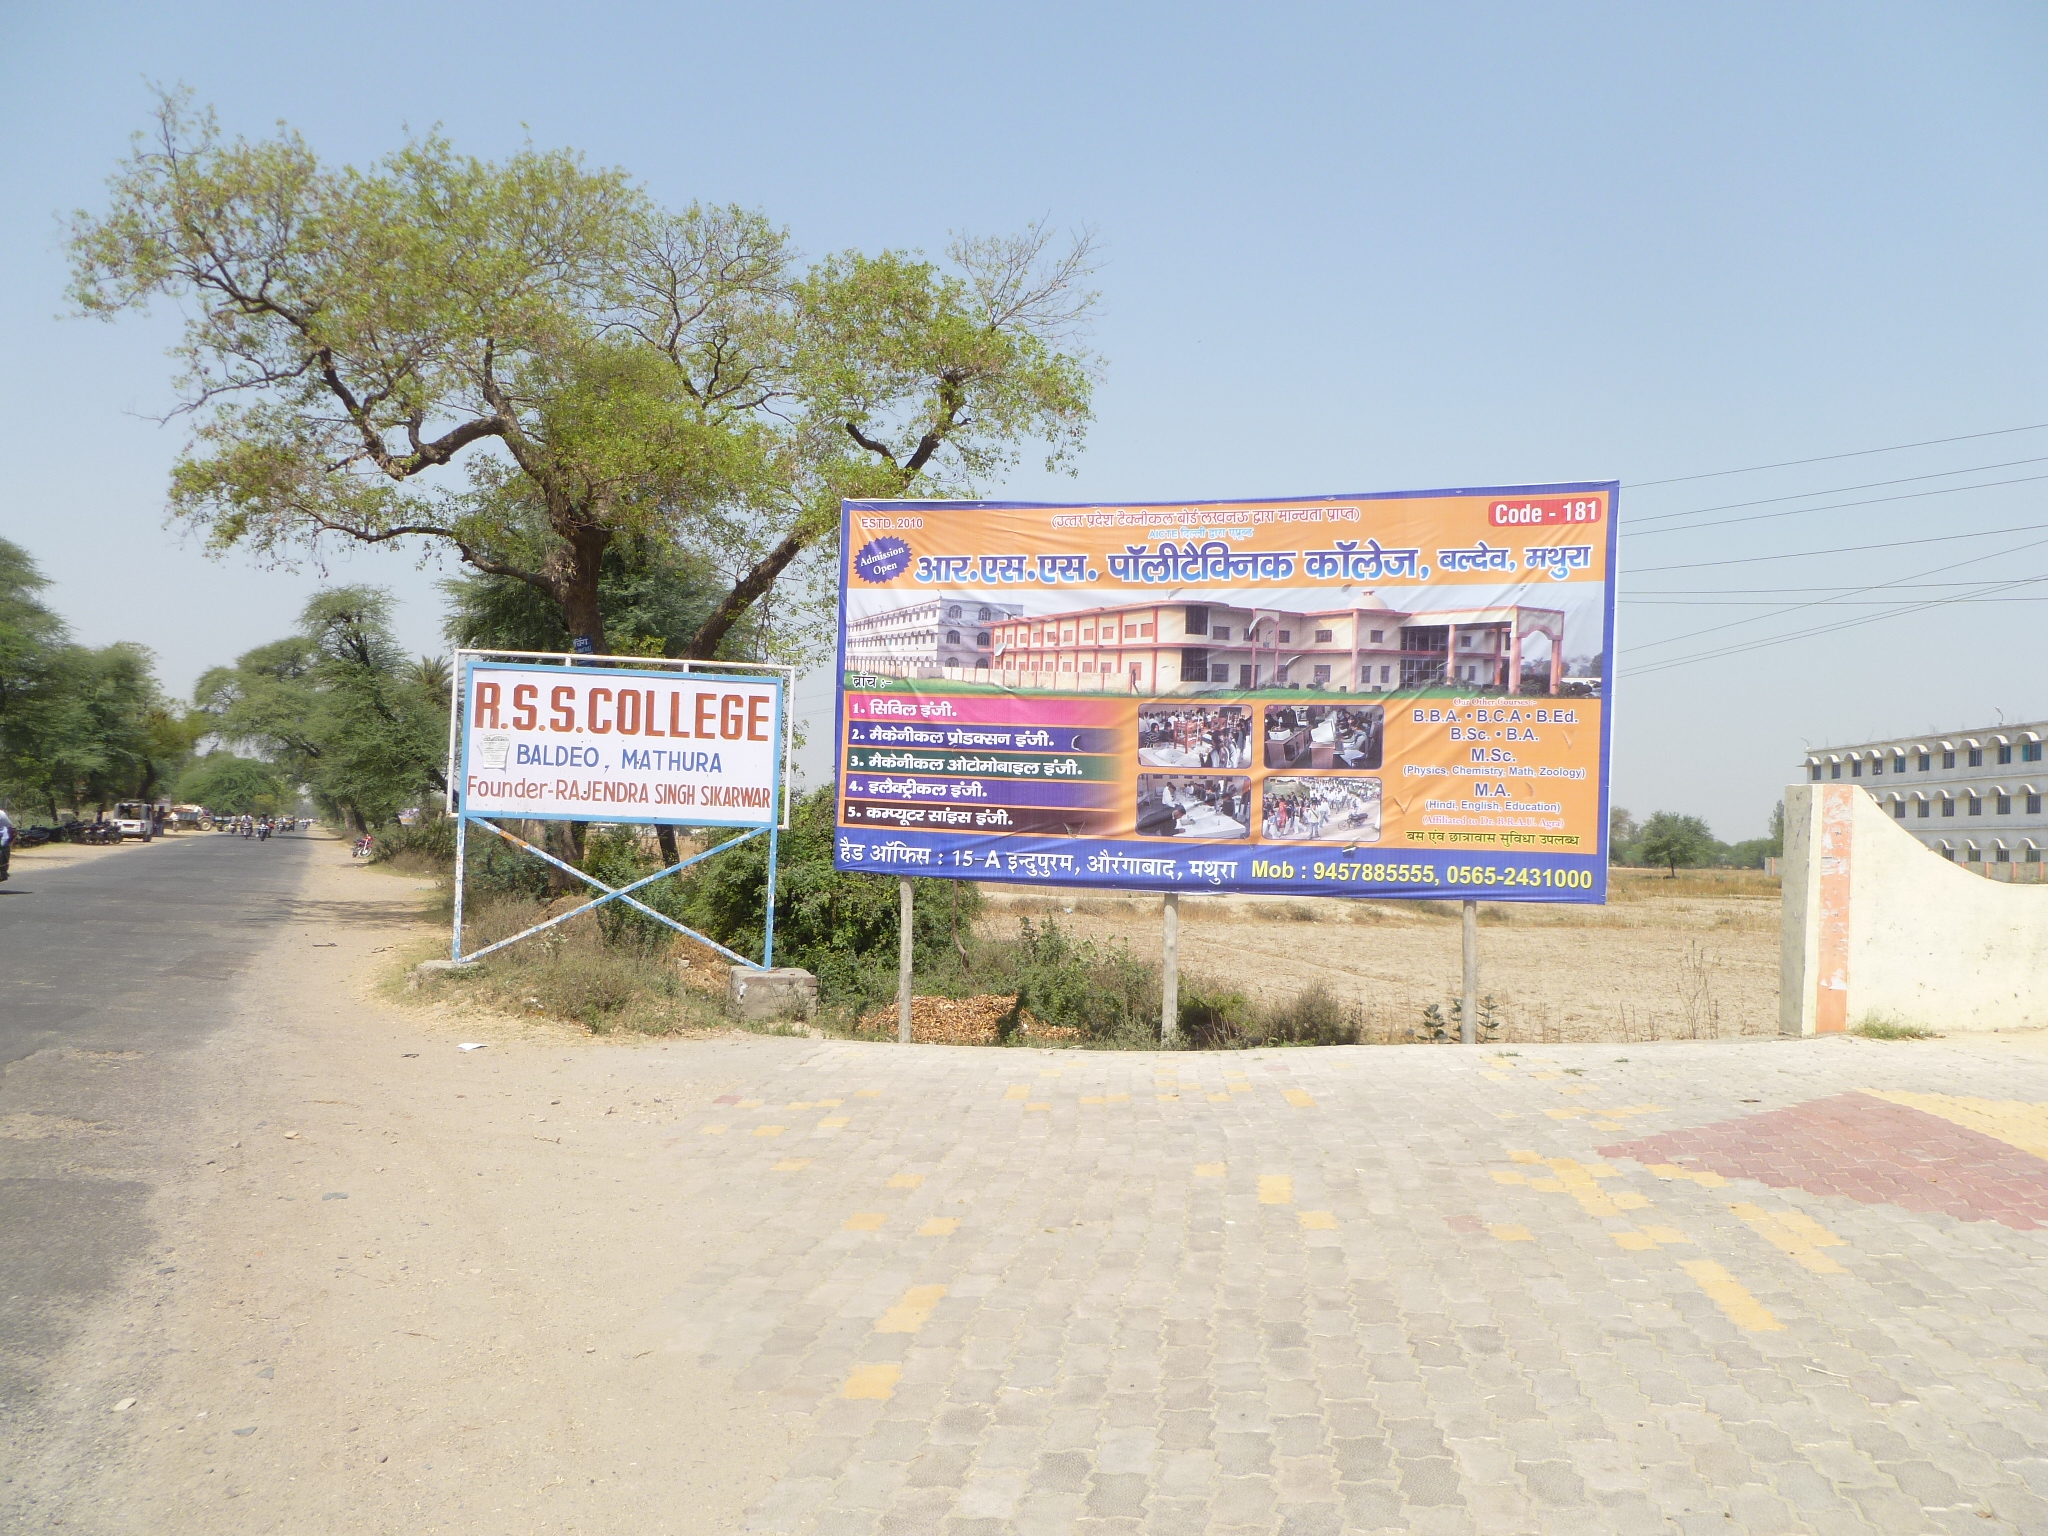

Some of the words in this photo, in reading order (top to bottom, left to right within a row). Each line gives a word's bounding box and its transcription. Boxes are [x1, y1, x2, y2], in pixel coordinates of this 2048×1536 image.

[1087, 511, 1114, 528] प्रदेश
[1178, 509, 1198, 524] बोर्ड
[1200, 510, 1250, 524] लखनऊ
[1252, 510, 1274, 524] द्वारा
[1278, 508, 1322, 522] मान्यता
[1326, 507, 1360, 522] प्राप्त)
[1495, 504, 1542, 524] Code
[1562, 501, 1596, 521] 181
[861, 517, 895, 530] ESTD.
[897, 516, 923, 530] 2010
[1148, 530, 1178, 539] AICTE
[860, 546, 904, 568] Admission
[914, 554, 1099, 584] आर.एस.एस.
[1304, 539, 1431, 580] कॉलेज,
[1438, 542, 1516, 573] बल्देव,
[1524, 545, 1592, 580] मथुरा
[872, 560, 898, 576] Open
[852, 704, 866, 714] 1.
[870, 699, 918, 717] सिविल
[920, 702, 958, 718] इंजी.
[1453, 698, 1470, 706] Our
[1471, 698, 1495, 706] Other
[1497, 698, 1528, 706] Courses
[1413, 709, 1462, 723] B.B.A.
[1477, 710, 1522, 723] B.C.A
[1536, 710, 1579, 724] B.Ed.
[852, 729, 865, 740] 2.
[869, 726, 944, 744] मैकेनीकल
[1016, 730, 1054, 748] इंजी.
[1450, 728, 1491, 740] B.Sc.
[1506, 728, 1540, 742] B.A.
[622, 749, 722, 773] MATHURA
[1471, 748, 1517, 762] M.Sc.
[850, 756, 864, 768] 3.
[869, 752, 944, 771] मैकेनीकल
[1044, 758, 1084, 776] इंजी.
[1403, 766, 1449, 776] (Physics,
[1452, 766, 1506, 777] Chemistry,
[1508, 767, 1537, 776] Math,
[1539, 767, 1586, 779] Zoology)
[654, 784, 695, 806] SINGH
[700, 785, 771, 809] SIKARWAR
[849, 781, 864, 792] 4.
[951, 781, 988, 798] इंजी.
[1474, 784, 1512, 797] M.A.
[1425, 800, 1458, 811] (Hindi,
[1461, 801, 1502, 812] English,
[1505, 802, 1562, 812] Education)
[848, 806, 862, 818] 5.
[976, 808, 1014, 826] इंजी.
[1468, 817, 1478, 825] to
[1480, 816, 1494, 826] Dr.
[1539, 818, 1564, 830] Agra)
[1406, 831, 1425, 842] बस
[1448, 831, 1496, 844] छात्रावास
[1500, 830, 1536, 848] सुविधा
[1539, 834, 1580, 846] उपलब्ध
[840, 838, 864, 862] हैड
[870, 840, 931, 866] ऑफिस
[953, 850, 1000, 869] 15-A
[1006, 850, 1080, 878] इन्दुपुरम,
[1086, 850, 1184, 881] औरंगाबाद,
[1189, 859, 1238, 885] मथुरा
[1251, 860, 1294, 880] Mob
[1313, 862, 1440, 886] 9457885555,
[1446, 865, 1592, 890] 0565-2431000
